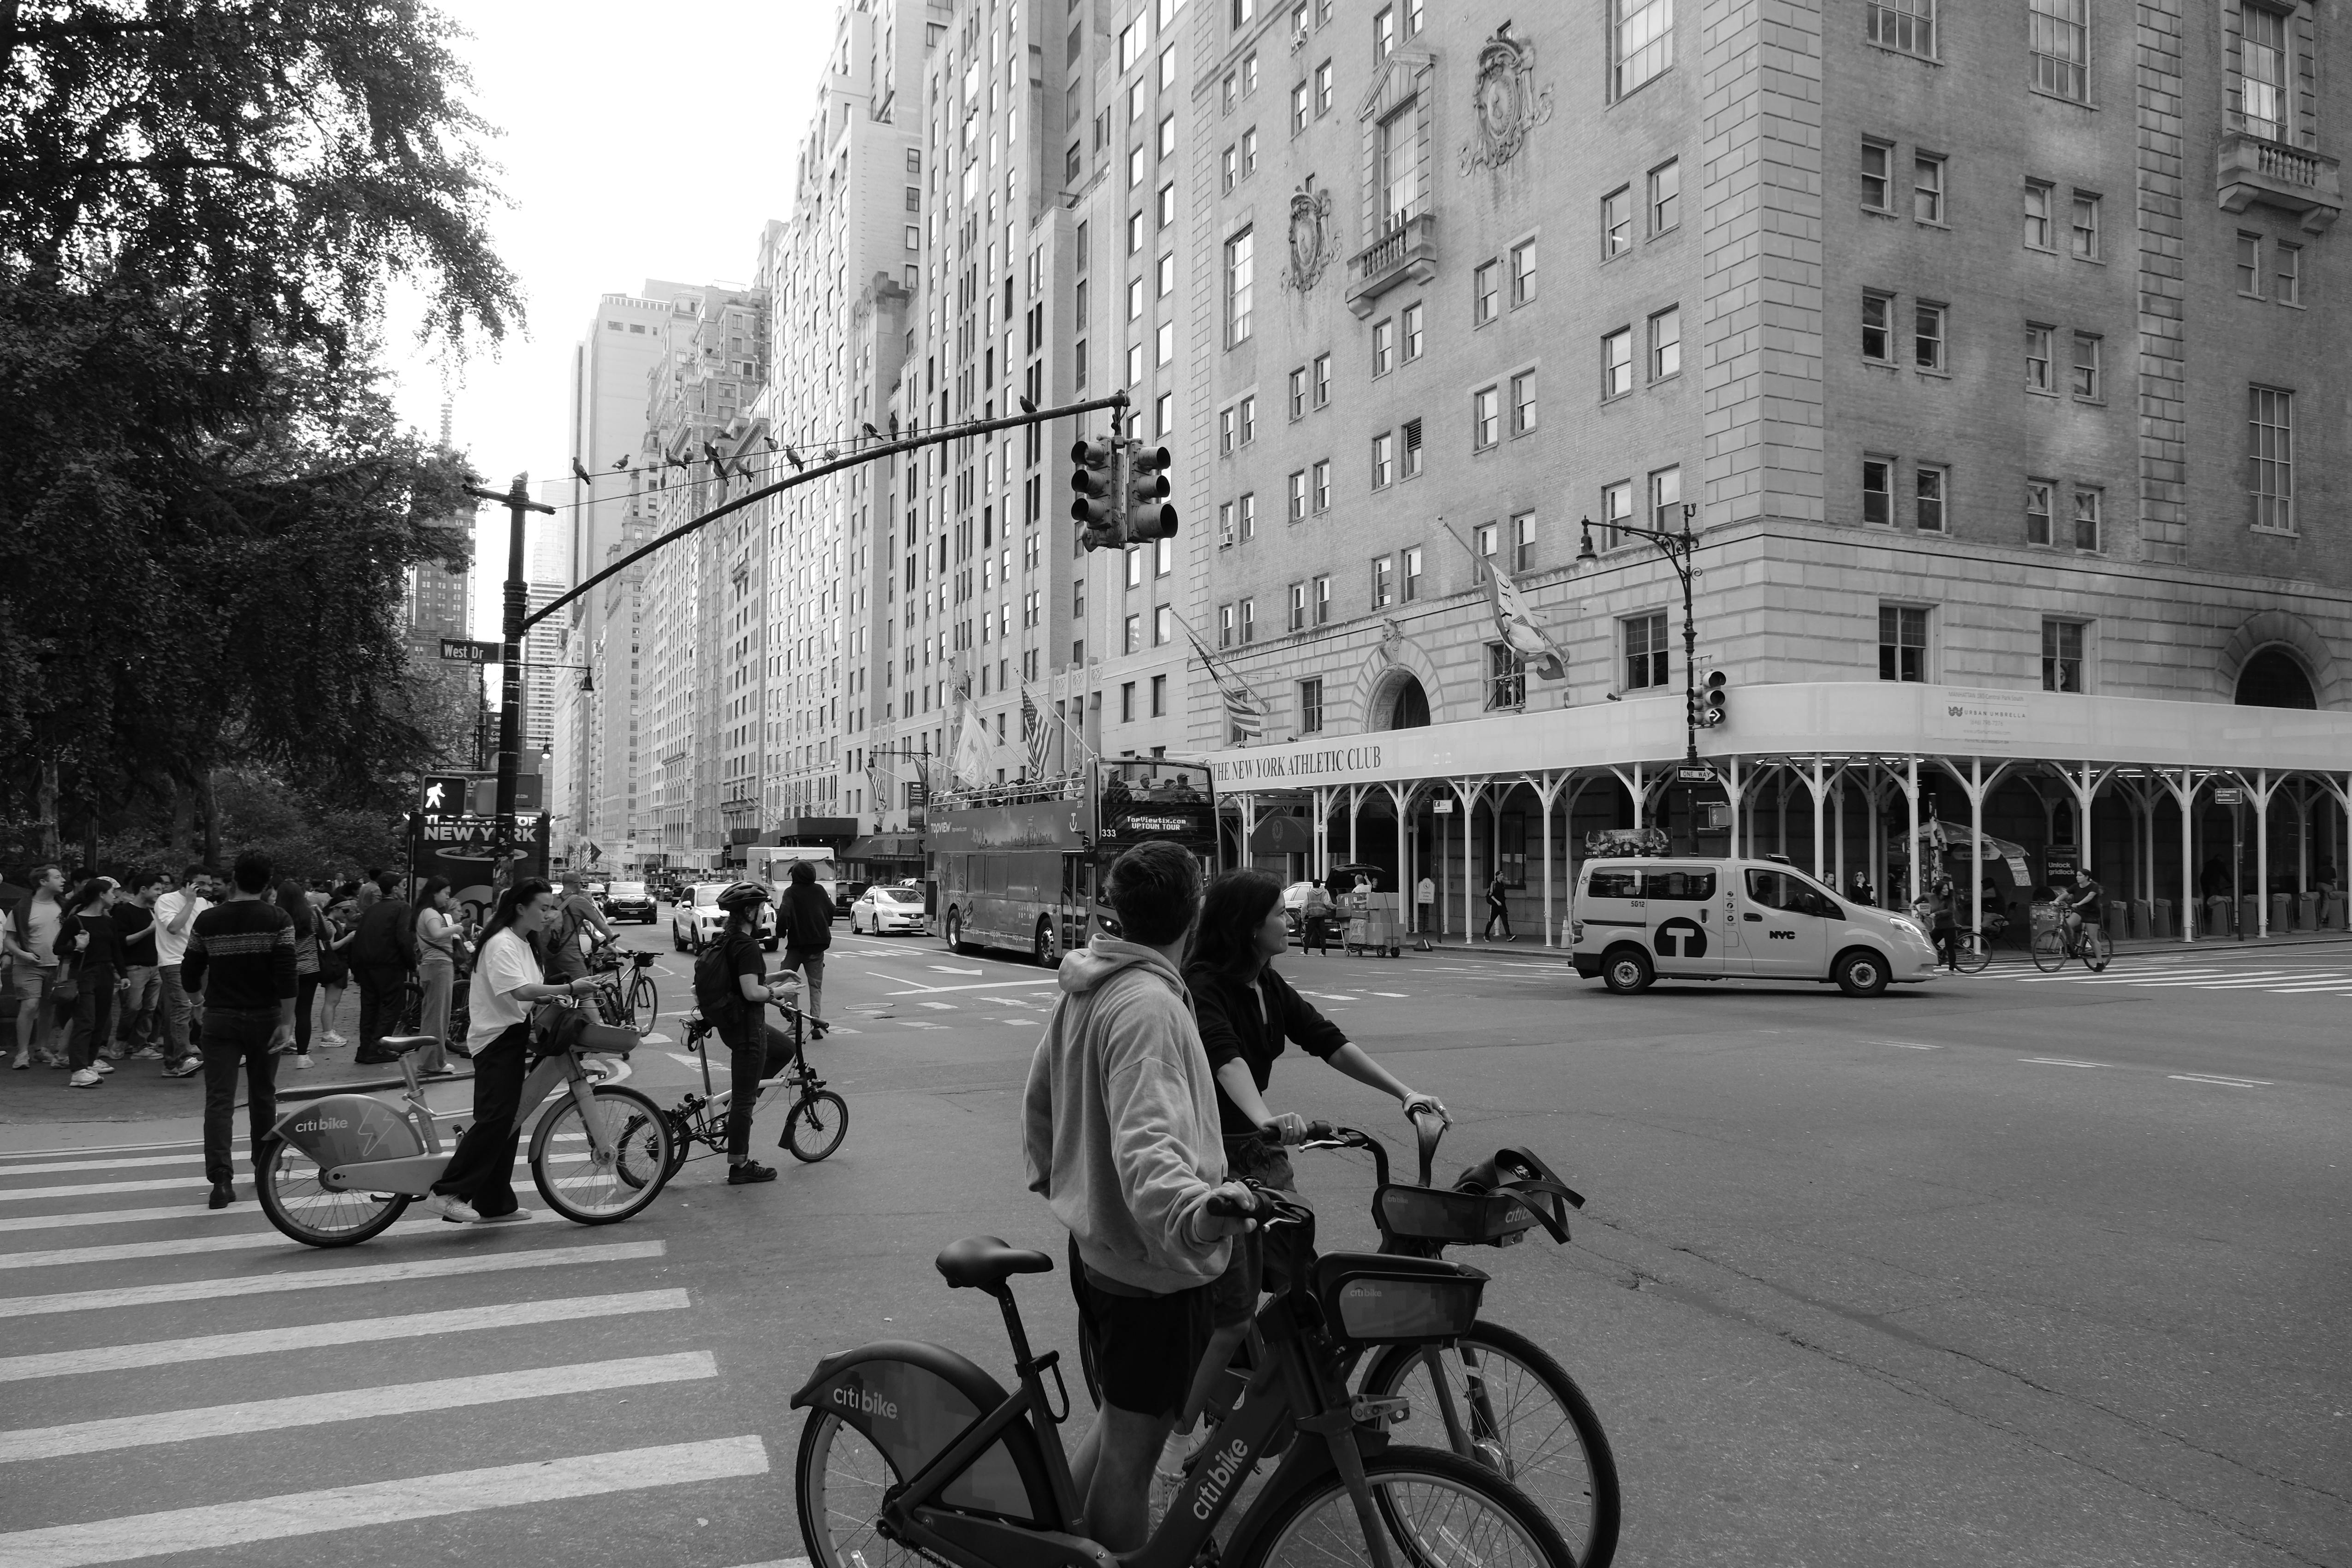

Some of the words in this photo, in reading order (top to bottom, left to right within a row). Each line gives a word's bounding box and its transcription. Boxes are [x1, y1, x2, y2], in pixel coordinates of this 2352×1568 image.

[444, 644, 468, 658] West
[471, 646, 484, 659] Dr
[1212, 762, 1229, 781] THE
[1232, 760, 1254, 780] NEW
[1256, 756, 1285, 778] YORK
[1287, 750, 1344, 775] ATHLETIC
[1348, 746, 1381, 770] CLUB
[517, 817, 537, 826] OF
[931, 817, 951, 839] TOPVIEW
[1127, 816, 1186, 825] TopViewtix.com
[424, 827, 475, 841] NEW
[480, 827, 536, 842] YRK
[1770, 931, 1795, 939] NYC
[295, 1120, 317, 1132] citi
[319, 1117, 348, 1130] bike
[1506, 1207, 1522, 1223] citi
[1365, 1289, 1382, 1297] bike
[833, 1388, 859, 1408] citi
[862, 1390, 898, 1419] bike
[1207, 1439, 1248, 1489] bike
[1194, 1481, 1222, 1520] citi
